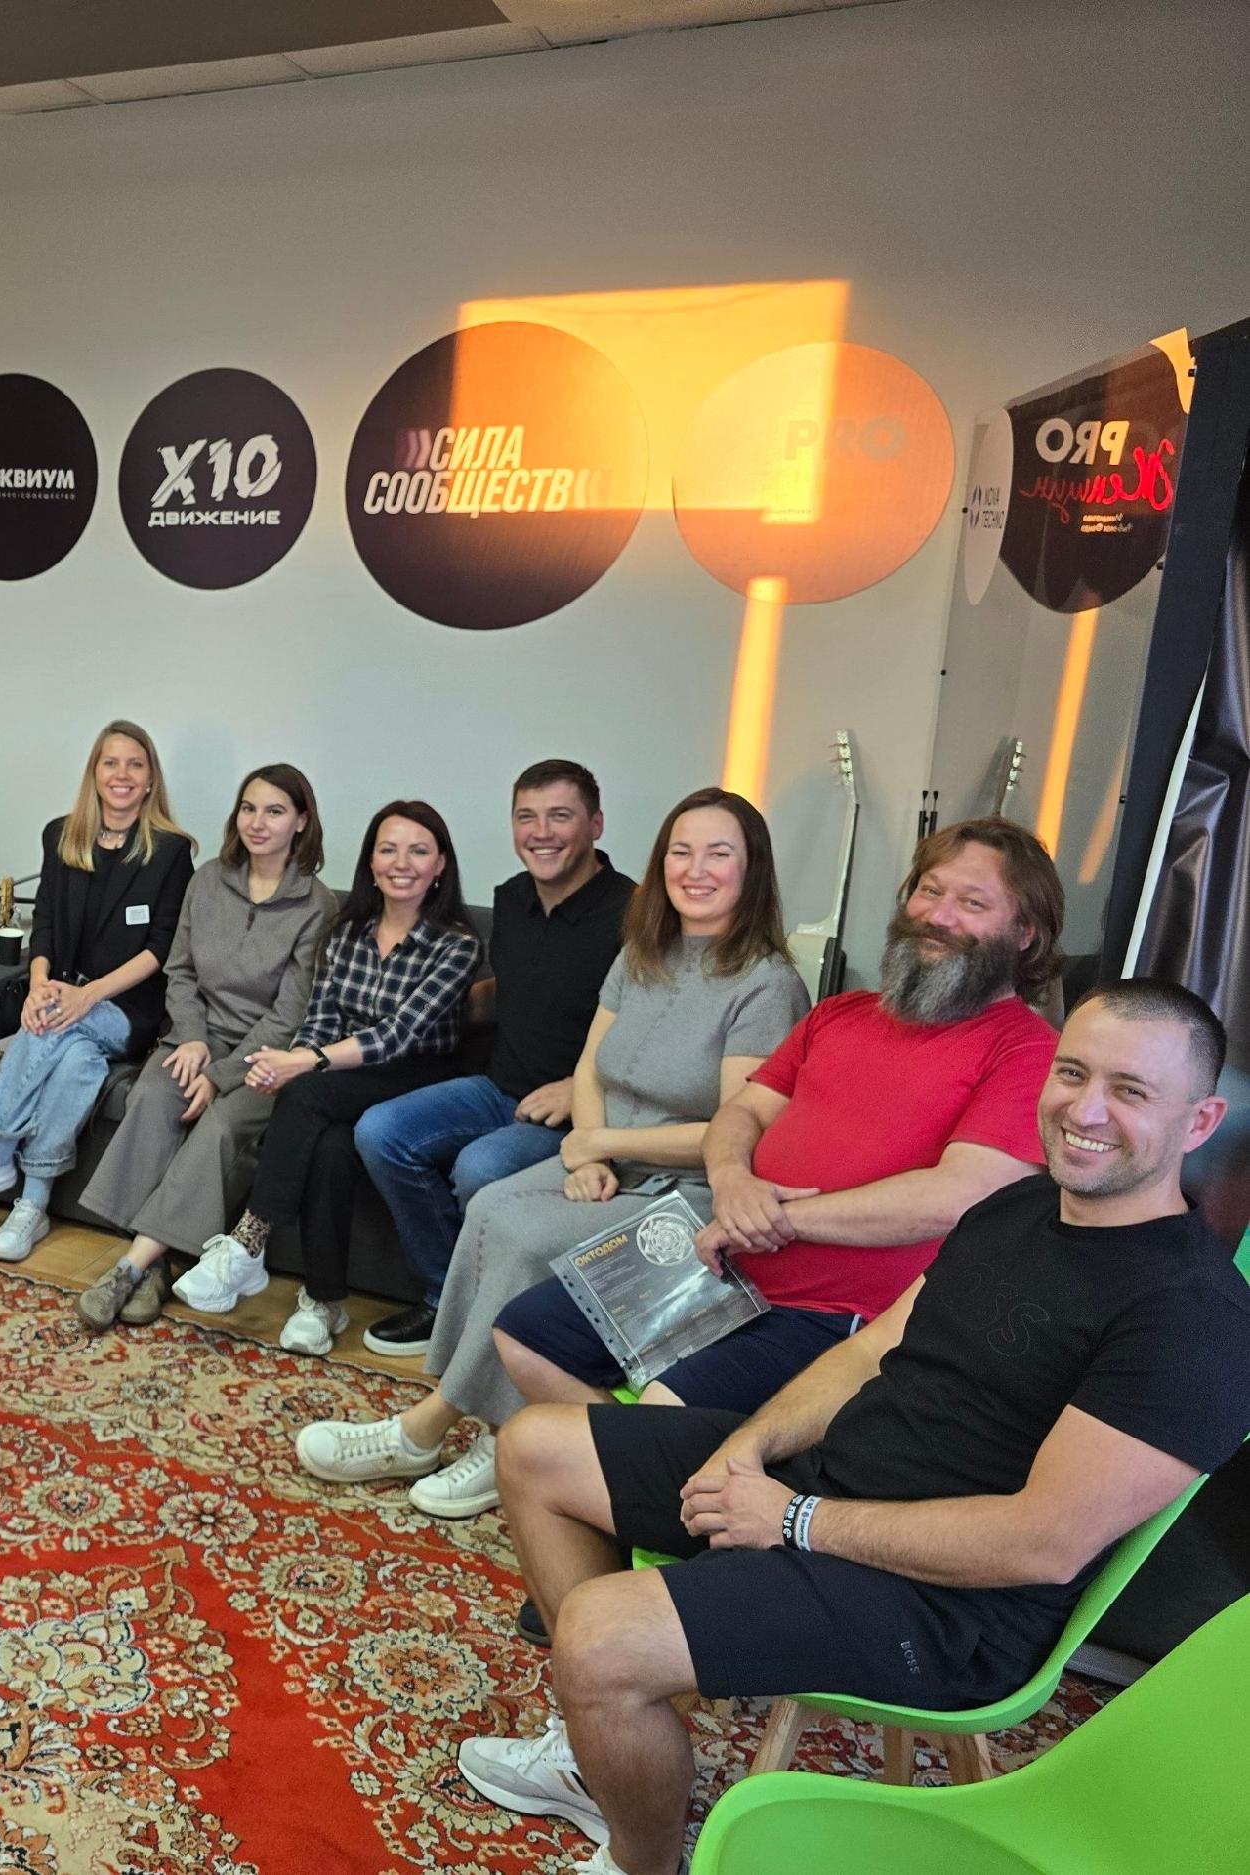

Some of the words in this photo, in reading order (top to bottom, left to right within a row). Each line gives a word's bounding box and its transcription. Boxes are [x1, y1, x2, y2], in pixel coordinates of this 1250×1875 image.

[428, 425, 525, 471] СИЛА
[363, 468, 574, 519] СООБЩЕСТВ
[148, 510, 281, 528] ДВИЖЕНИЕ
[574, 1233, 629, 1268] ОКТОДОМ
[900, 1641, 920, 1675] BOSS
